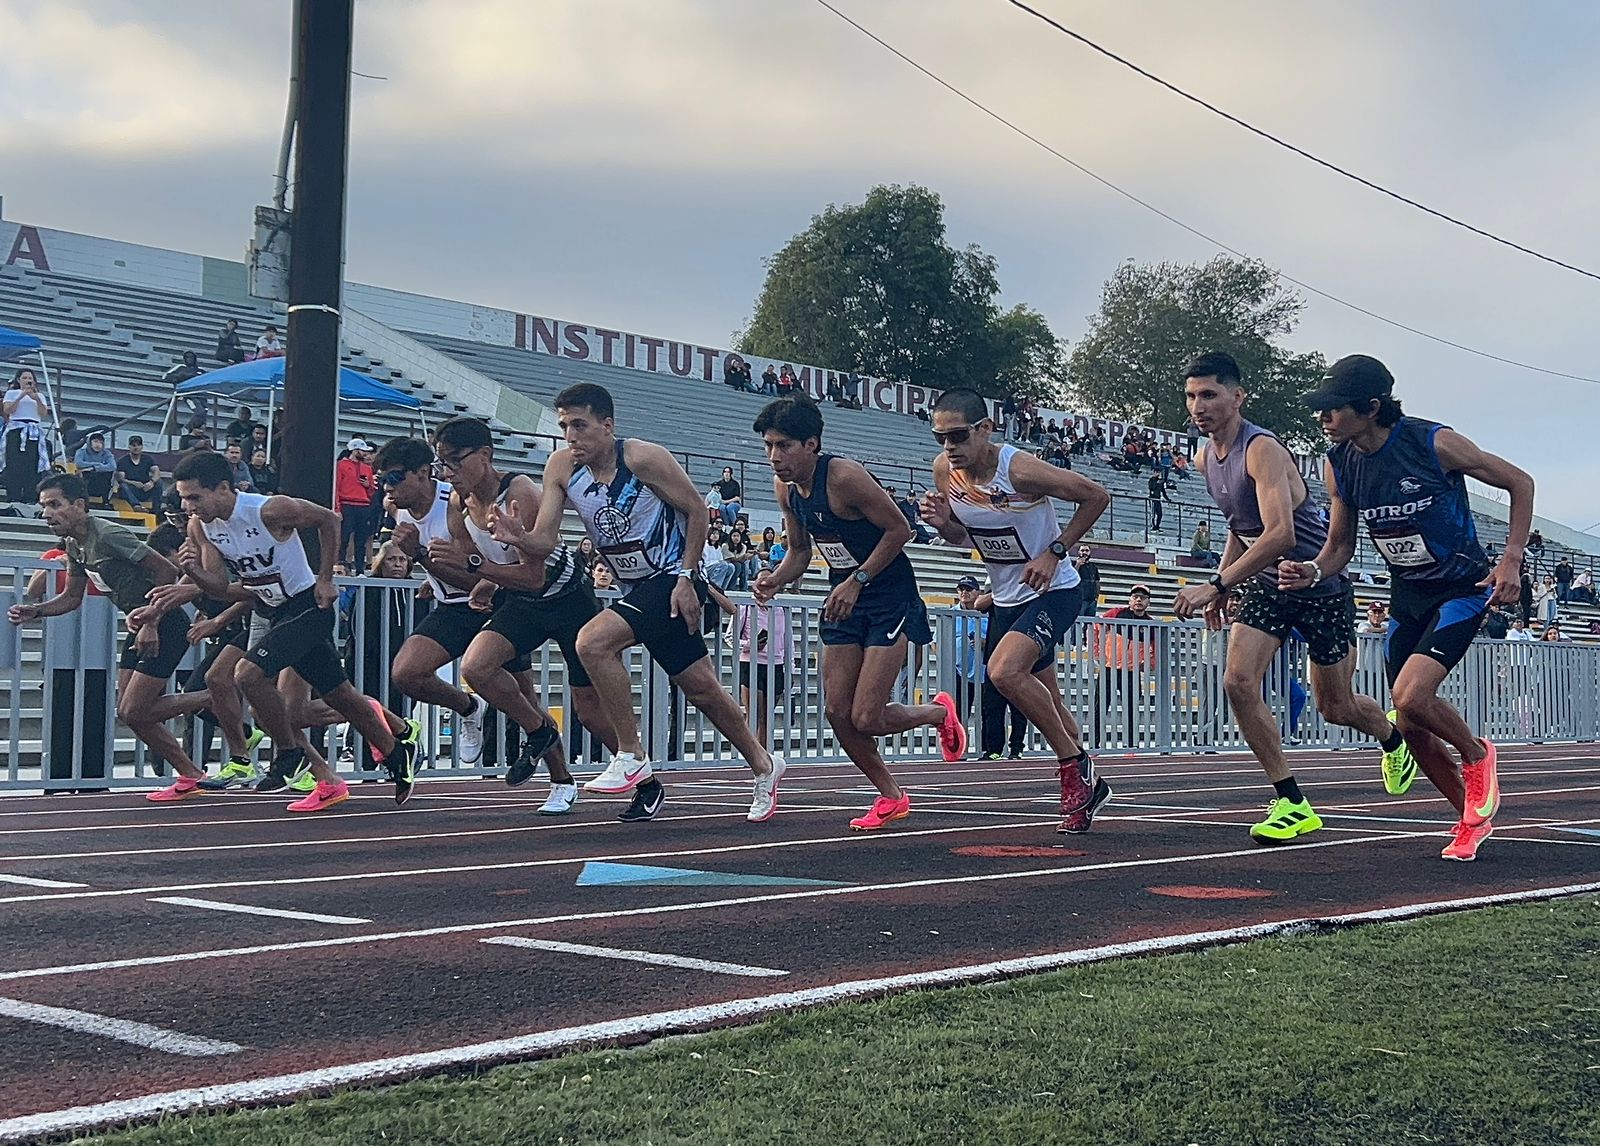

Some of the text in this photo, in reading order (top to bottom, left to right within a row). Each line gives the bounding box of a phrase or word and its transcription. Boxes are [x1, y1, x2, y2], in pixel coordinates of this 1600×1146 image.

[6, 226, 50, 270] A
[983, 539, 1010, 550] 008
[1386, 541, 1418, 555] 022
[615, 556, 638, 569] 009
